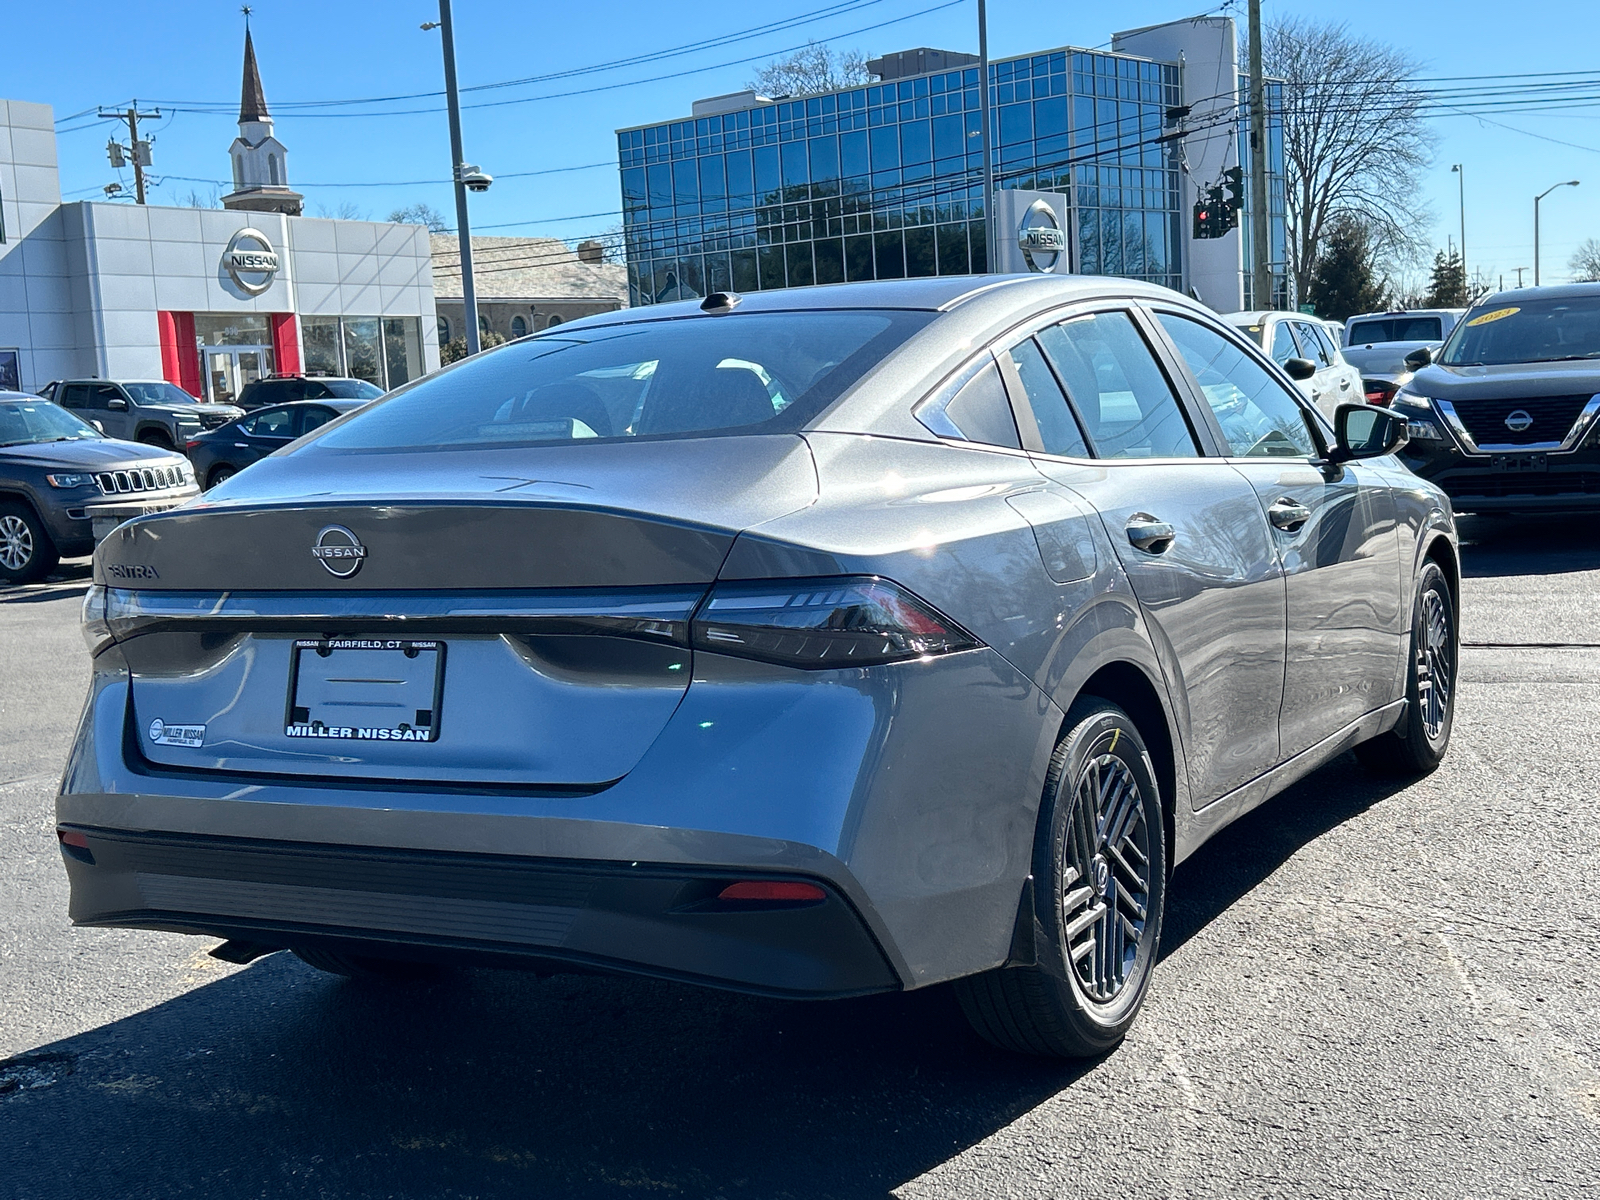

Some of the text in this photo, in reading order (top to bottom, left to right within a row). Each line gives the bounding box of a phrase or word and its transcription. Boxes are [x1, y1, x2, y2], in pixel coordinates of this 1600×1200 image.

[1026, 233, 1063, 246] NISSAN
[231, 255, 277, 267] NISSAN
[312, 548, 364, 557] NISSAN
[328, 640, 384, 649] FAIRFIELD,
[286, 725, 430, 741] MILLER NISSAN
